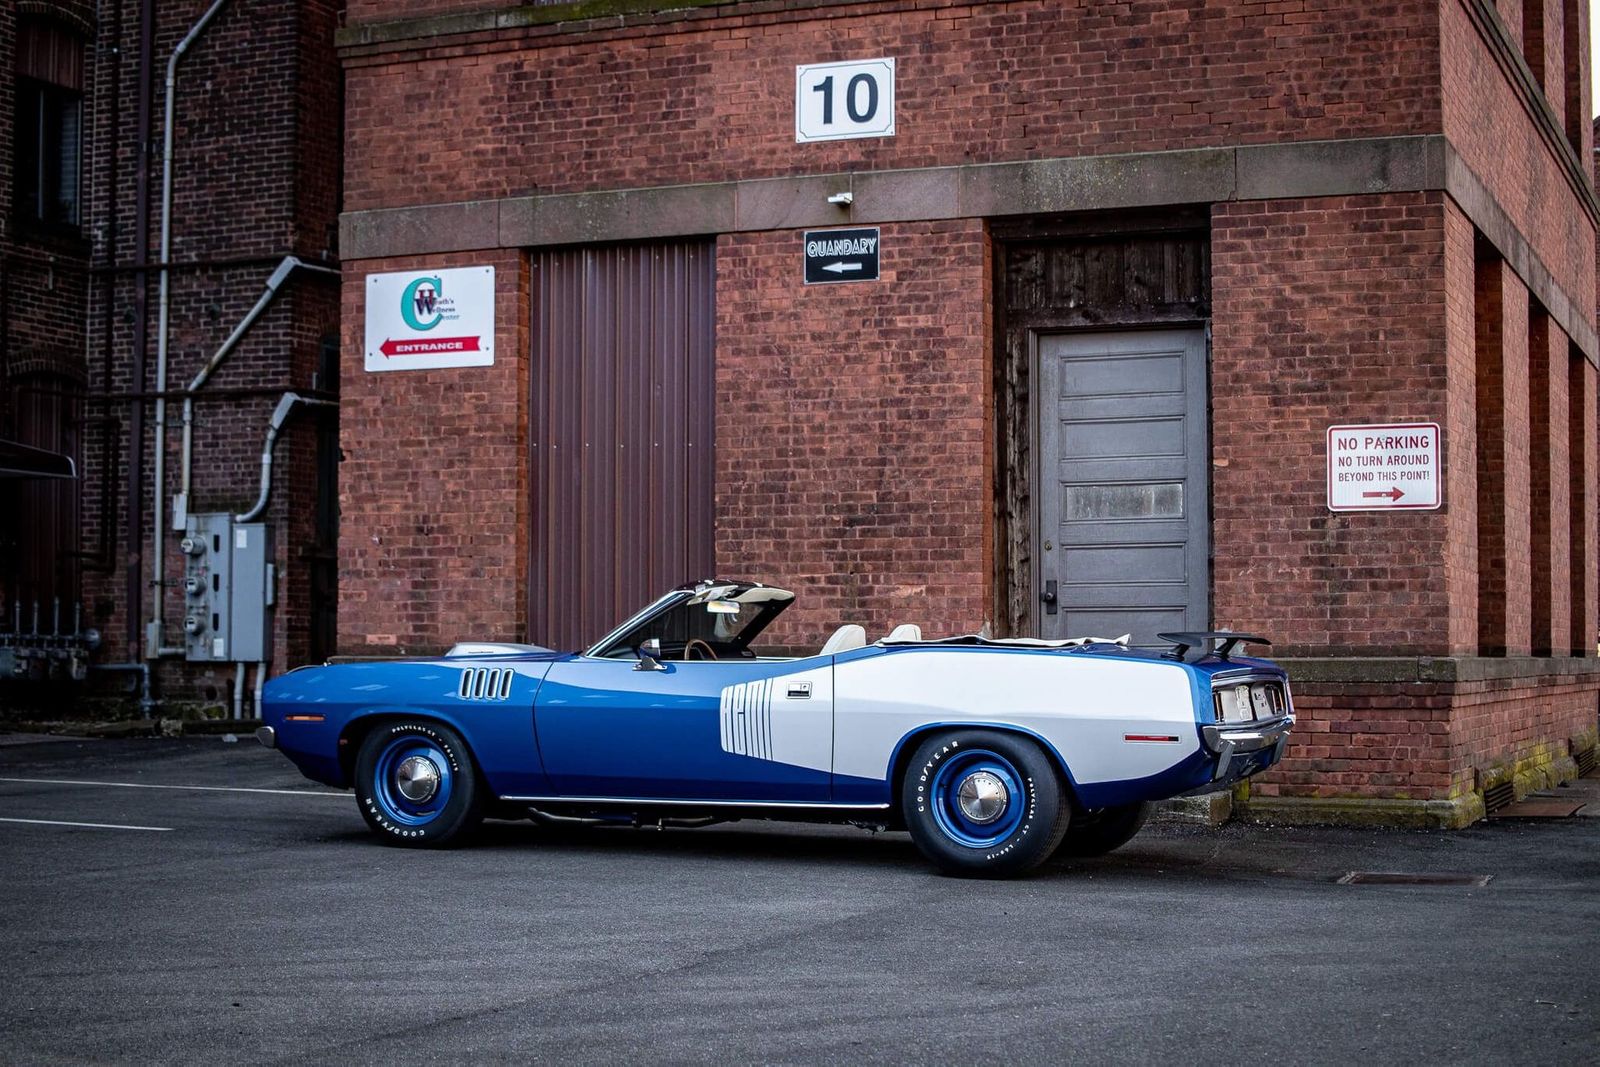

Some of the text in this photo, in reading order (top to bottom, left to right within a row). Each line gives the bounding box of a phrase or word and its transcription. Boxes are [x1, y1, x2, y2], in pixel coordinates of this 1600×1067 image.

[813, 73, 879, 125] 10
[807, 238, 877, 258] QUANDARY
[396, 341, 464, 352] ENTRANCE
[1338, 435, 1429, 450] NO PARKING
[1338, 454, 1430, 467] NO TURN AROUND
[1338, 470, 1430, 482] BEYOND THIS POINT!
[917, 740, 959, 812] GOODYEAR
[365, 797, 425, 837] GOODYEAR
